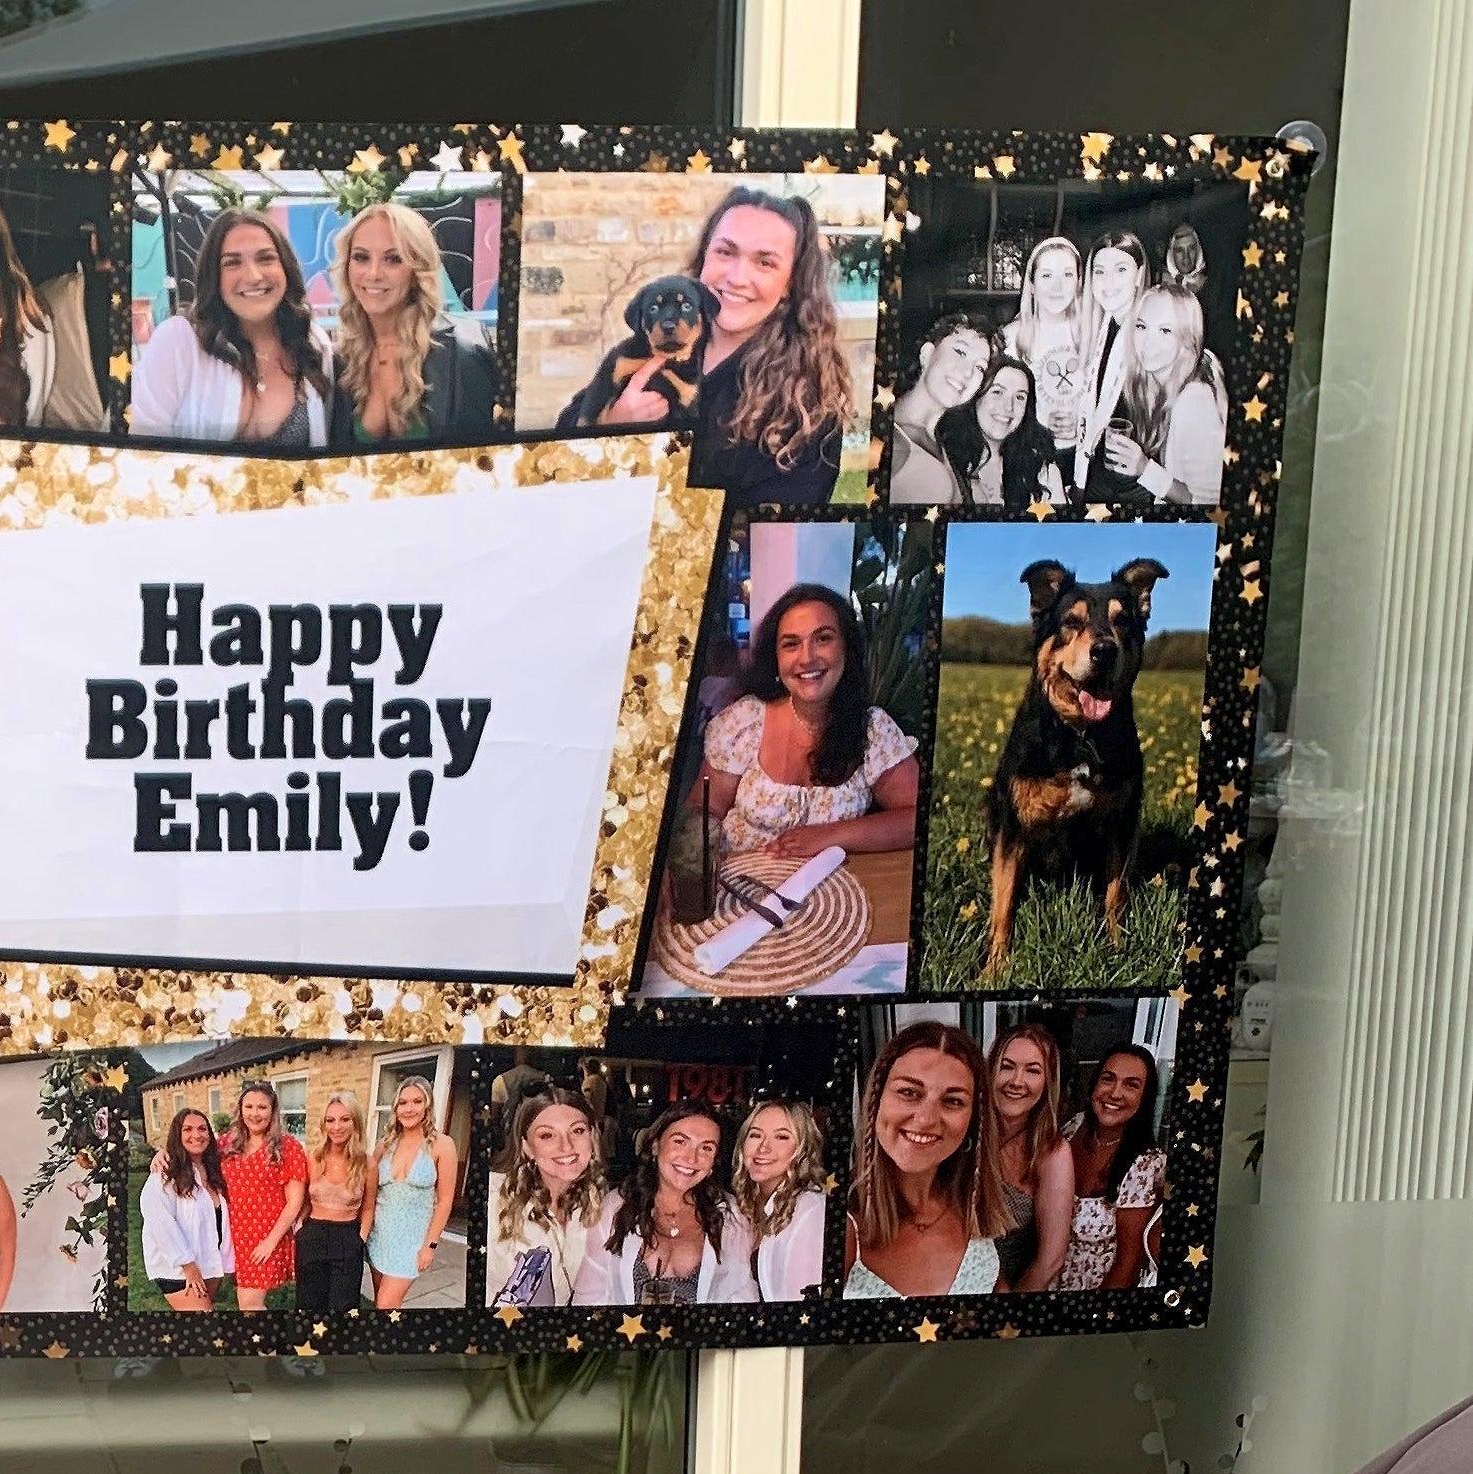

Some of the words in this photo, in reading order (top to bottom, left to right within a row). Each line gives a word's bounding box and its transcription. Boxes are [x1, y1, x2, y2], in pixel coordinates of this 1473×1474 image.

[139, 582, 444, 686] Happy
[85, 677, 493, 779] Birthday
[133, 769, 435, 872] Emily!
